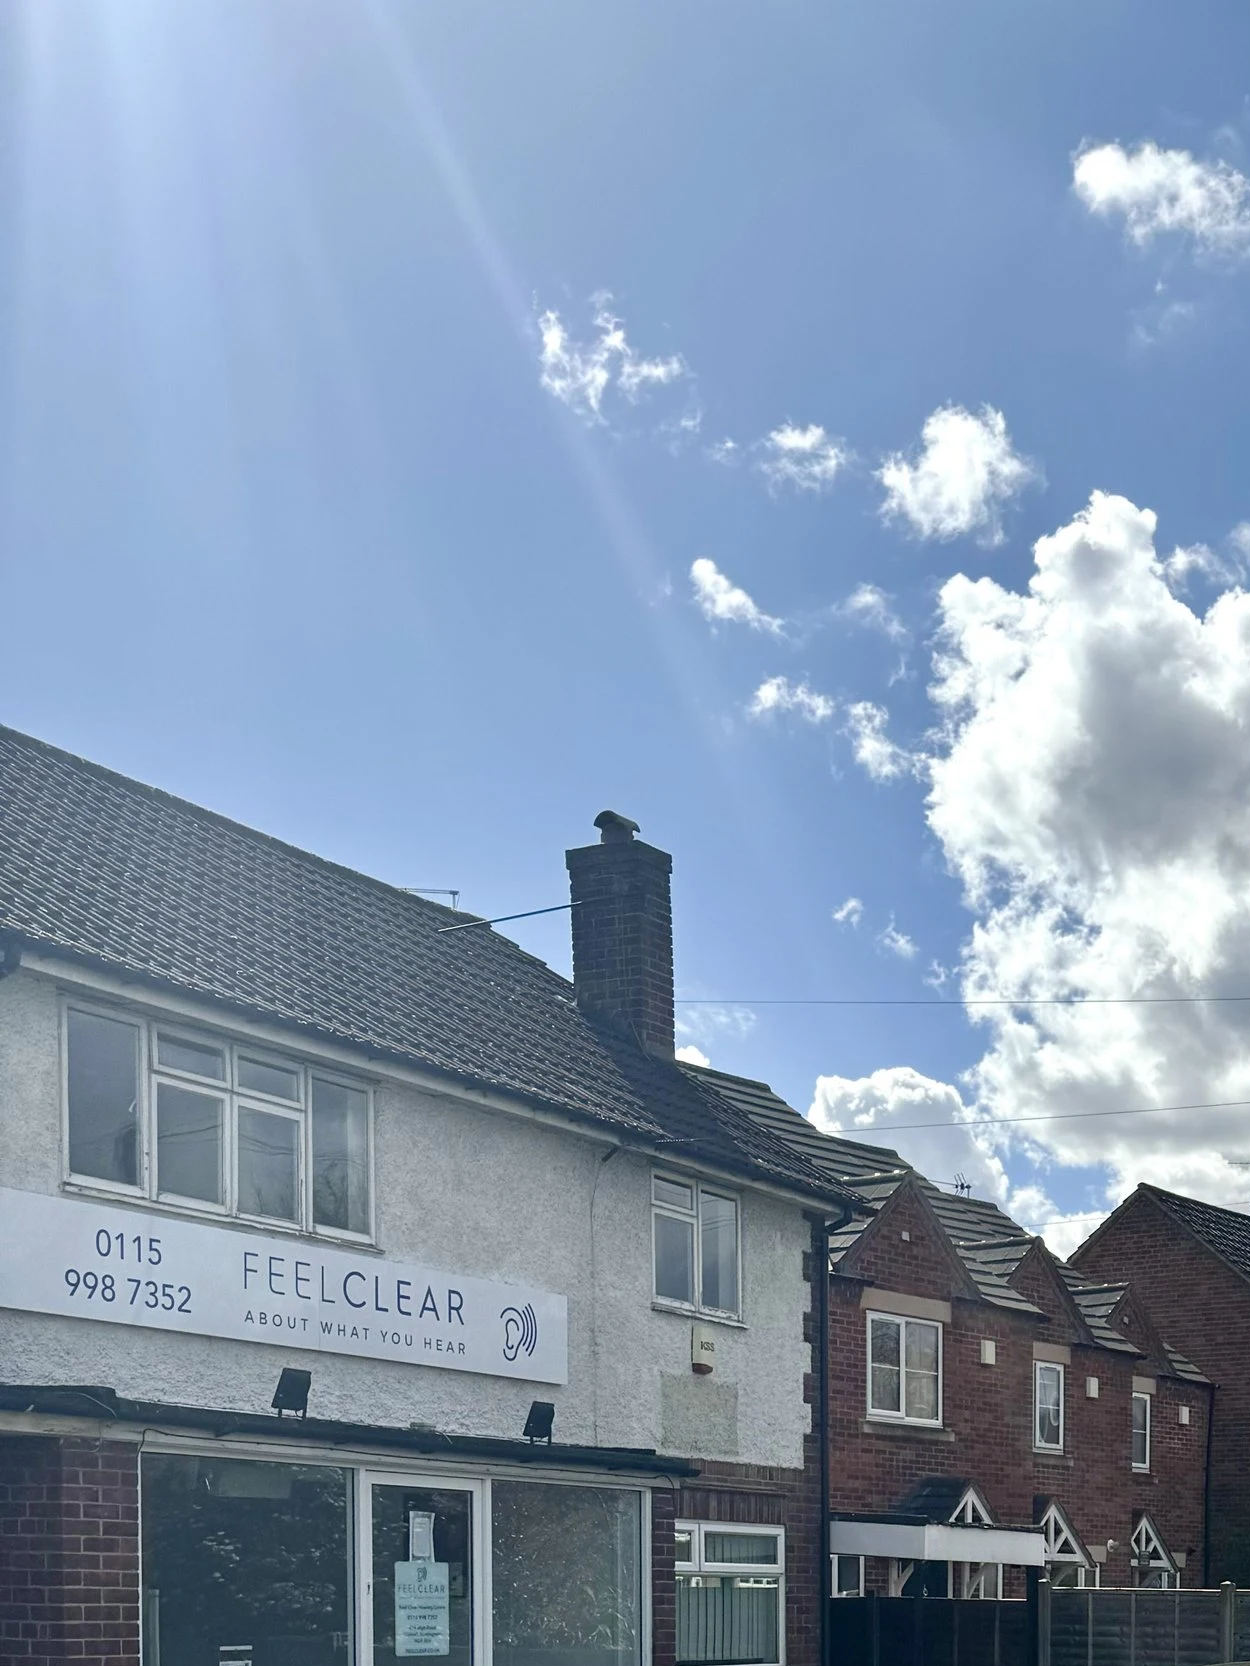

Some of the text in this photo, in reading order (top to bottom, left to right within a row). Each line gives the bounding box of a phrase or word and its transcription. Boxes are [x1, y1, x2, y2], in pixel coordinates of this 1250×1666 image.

[95, 1228, 162, 1266] 0115
[64, 1268, 192, 1314] 998 7352
[243, 1251, 465, 1326] FEELCLEAR
[244, 1310, 466, 1355] ABOUT WHAT YOU HEAR
